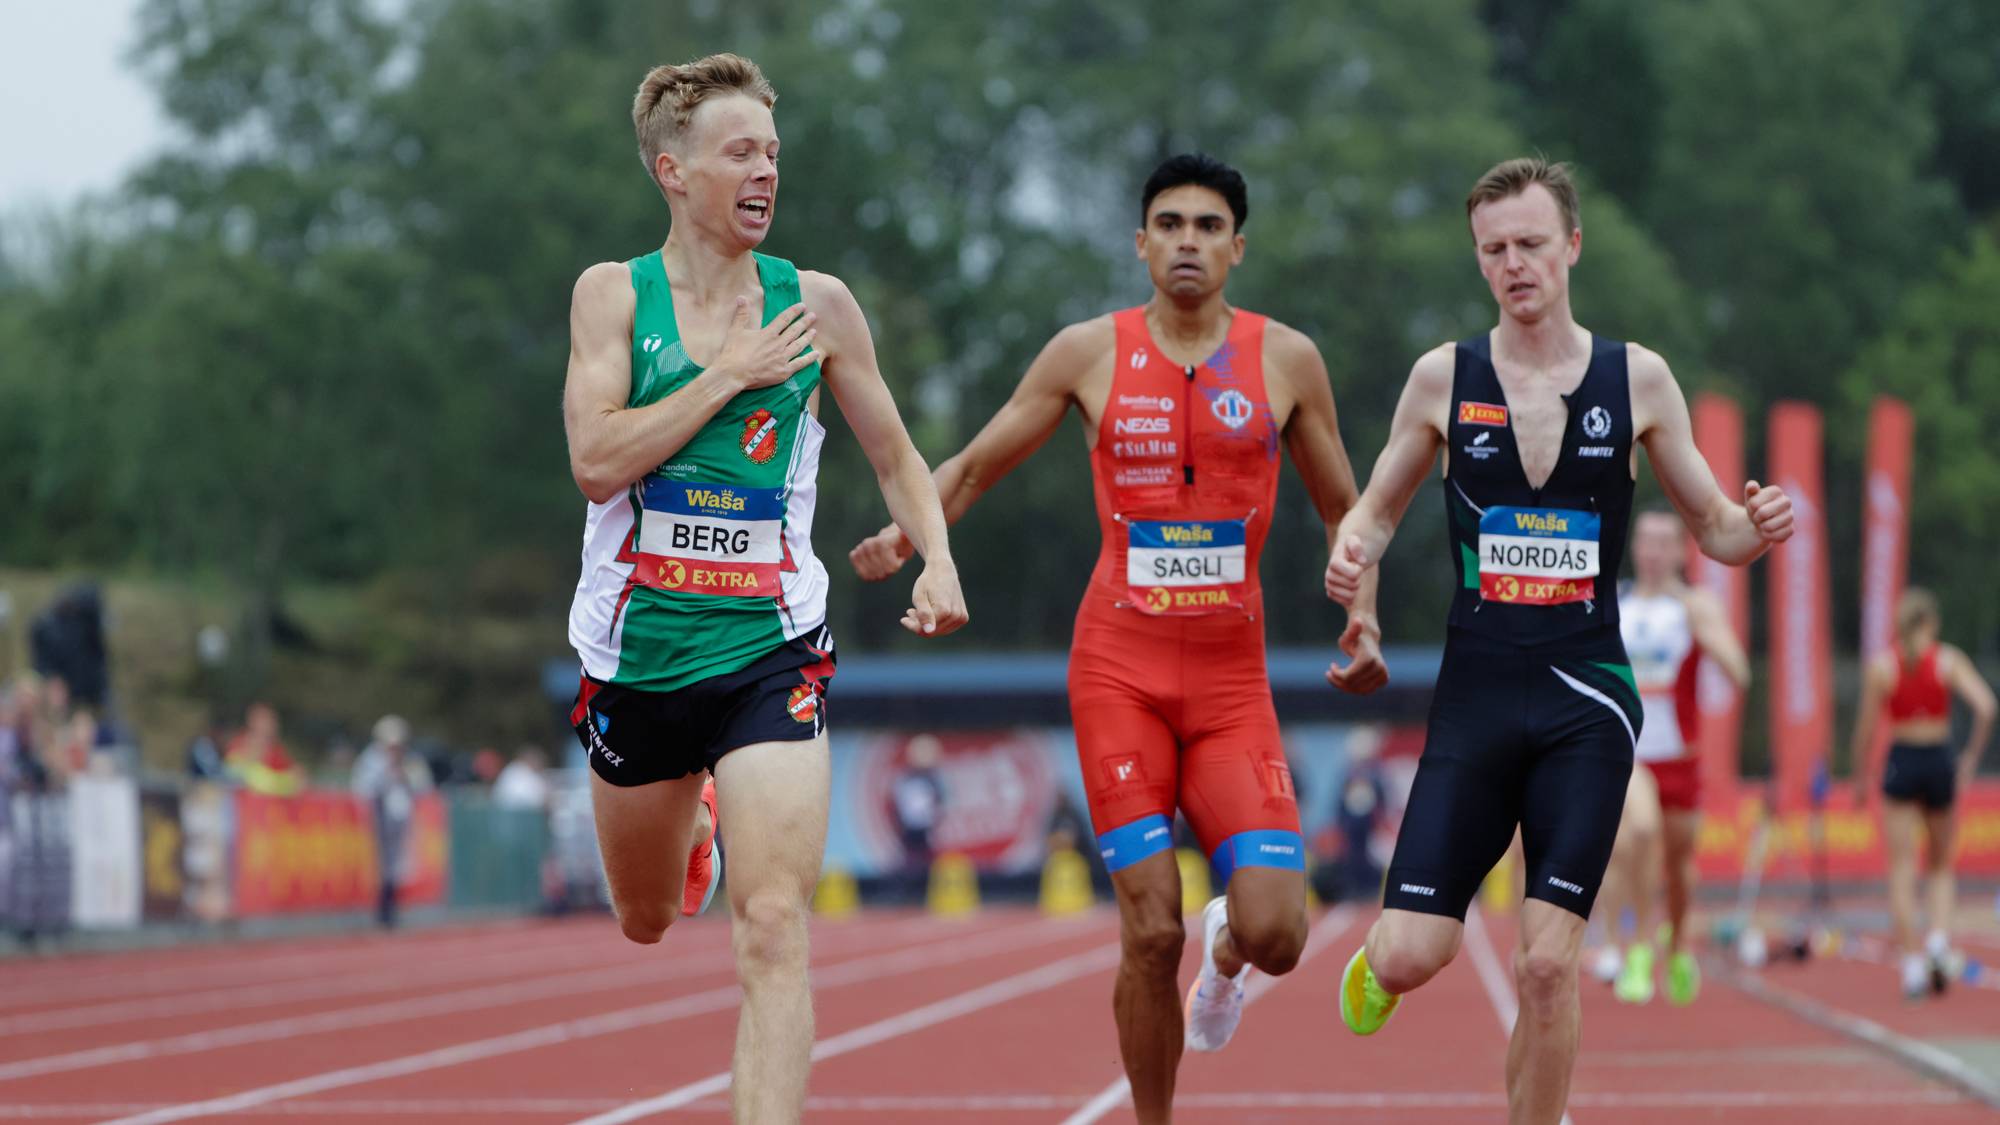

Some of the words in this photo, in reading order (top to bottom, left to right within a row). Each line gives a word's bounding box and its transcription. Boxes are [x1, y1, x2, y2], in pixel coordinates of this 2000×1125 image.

[1115, 417, 1170, 434] NEAS
[1578, 446, 1615, 457] TRIMTEX
[685, 488, 745, 511] Wasa
[1515, 512, 1568, 532] Wasa
[672, 523, 749, 554] BERG
[1160, 524, 1213, 543] Wasa
[1491, 543, 1588, 571] NORDÅS
[1154, 556, 1221, 578] SAGLI
[692, 569, 758, 588] EXTRA
[1175, 590, 1229, 606] EXTRA
[1524, 583, 1577, 600] EXTRA
[1260, 843, 1295, 855] TRIMTEX
[1400, 883, 1436, 897] TRIMTEX
[1547, 876, 1584, 895] TRIMTEX
